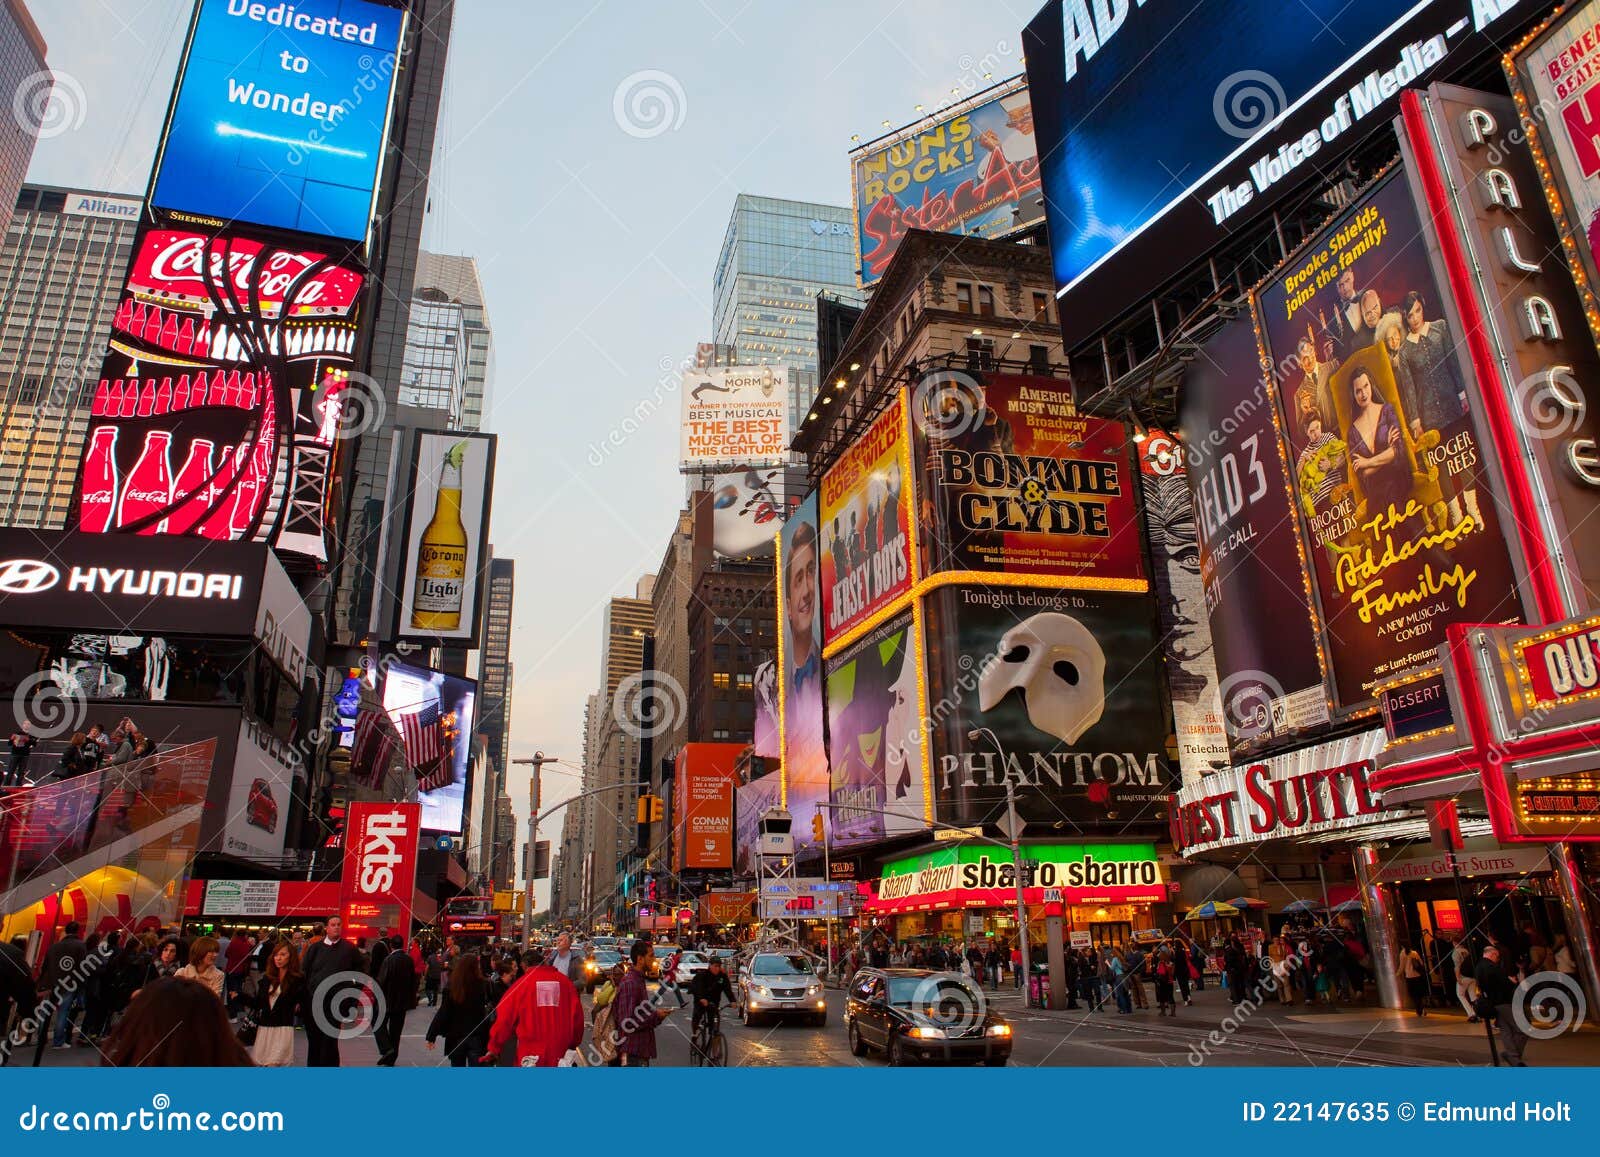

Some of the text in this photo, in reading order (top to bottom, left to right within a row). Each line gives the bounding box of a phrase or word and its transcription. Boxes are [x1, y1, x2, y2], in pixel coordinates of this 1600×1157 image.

[226, 0, 377, 45] Dedicated
[280, 50, 309, 74] to
[228, 77, 343, 121] Wonder
[1207, 179, 1254, 225] The
[1249, 128, 1322, 193] Voice
[1320, 92, 1352, 143] of
[1349, 33, 1449, 121] Media
[864, 115, 972, 182] NUNS
[78, 198, 137, 217] Allianz
[1285, 204, 1379, 295] Brooke Shields
[1285, 218, 1388, 320] joins the family!
[689, 409, 782, 420] BEST MUSICAL
[1008, 400, 1045, 414] MOST
[1026, 414, 1087, 432] Broadway
[688, 433, 782, 447] MUSICAL OF
[732, 420, 782, 434] BEST
[1032, 428, 1083, 443] Musical
[689, 446, 718, 456] THIS
[824, 401, 901, 488] THE CROWD
[1428, 431, 1474, 467] ROGER
[1447, 447, 1477, 476] REES
[826, 464, 860, 507] GOES
[939, 449, 1121, 496] BONNIE
[1241, 433, 1267, 505] 3
[127, 489, 167, 503] Coca-Cola
[1022, 478, 1048, 503] &
[959, 492, 1110, 537] CLYDE
[1310, 497, 1353, 532] BROOKE
[1315, 513, 1357, 548] SHIELDS
[1361, 499, 1423, 541] The
[422, 547, 464, 563] Corona
[975, 544, 998, 554] Gerald
[1212, 522, 1258, 565] THE CALL
[1336, 514, 1475, 593] Addams
[67, 566, 242, 600] HYUNDAI
[421, 578, 458, 598] Light
[830, 555, 873, 630] JERSEY
[873, 532, 908, 599] BOYS
[1351, 563, 1477, 623] Family
[961, 589, 1013, 608] Tonight
[1017, 591, 1069, 610] belongs
[1377, 601, 1450, 637] A NEW MUSICAL
[1395, 620, 1432, 642] COMEDY
[1390, 684, 1441, 712] DESERT
[1273, 706, 1285, 727] RP
[940, 752, 1163, 790] PHANTOM
[1122, 793, 1147, 802] MAJESTIC
[692, 817, 729, 825] CONAN
[360, 811, 407, 894] tkts
[1431, 859, 1468, 874] GUST
[882, 871, 913, 899] sbarro
[918, 862, 954, 894] sbarro
[963, 855, 1056, 888] sbaro
[1068, 855, 1156, 887] sbarro
[713, 904, 751, 917] GIFTS
